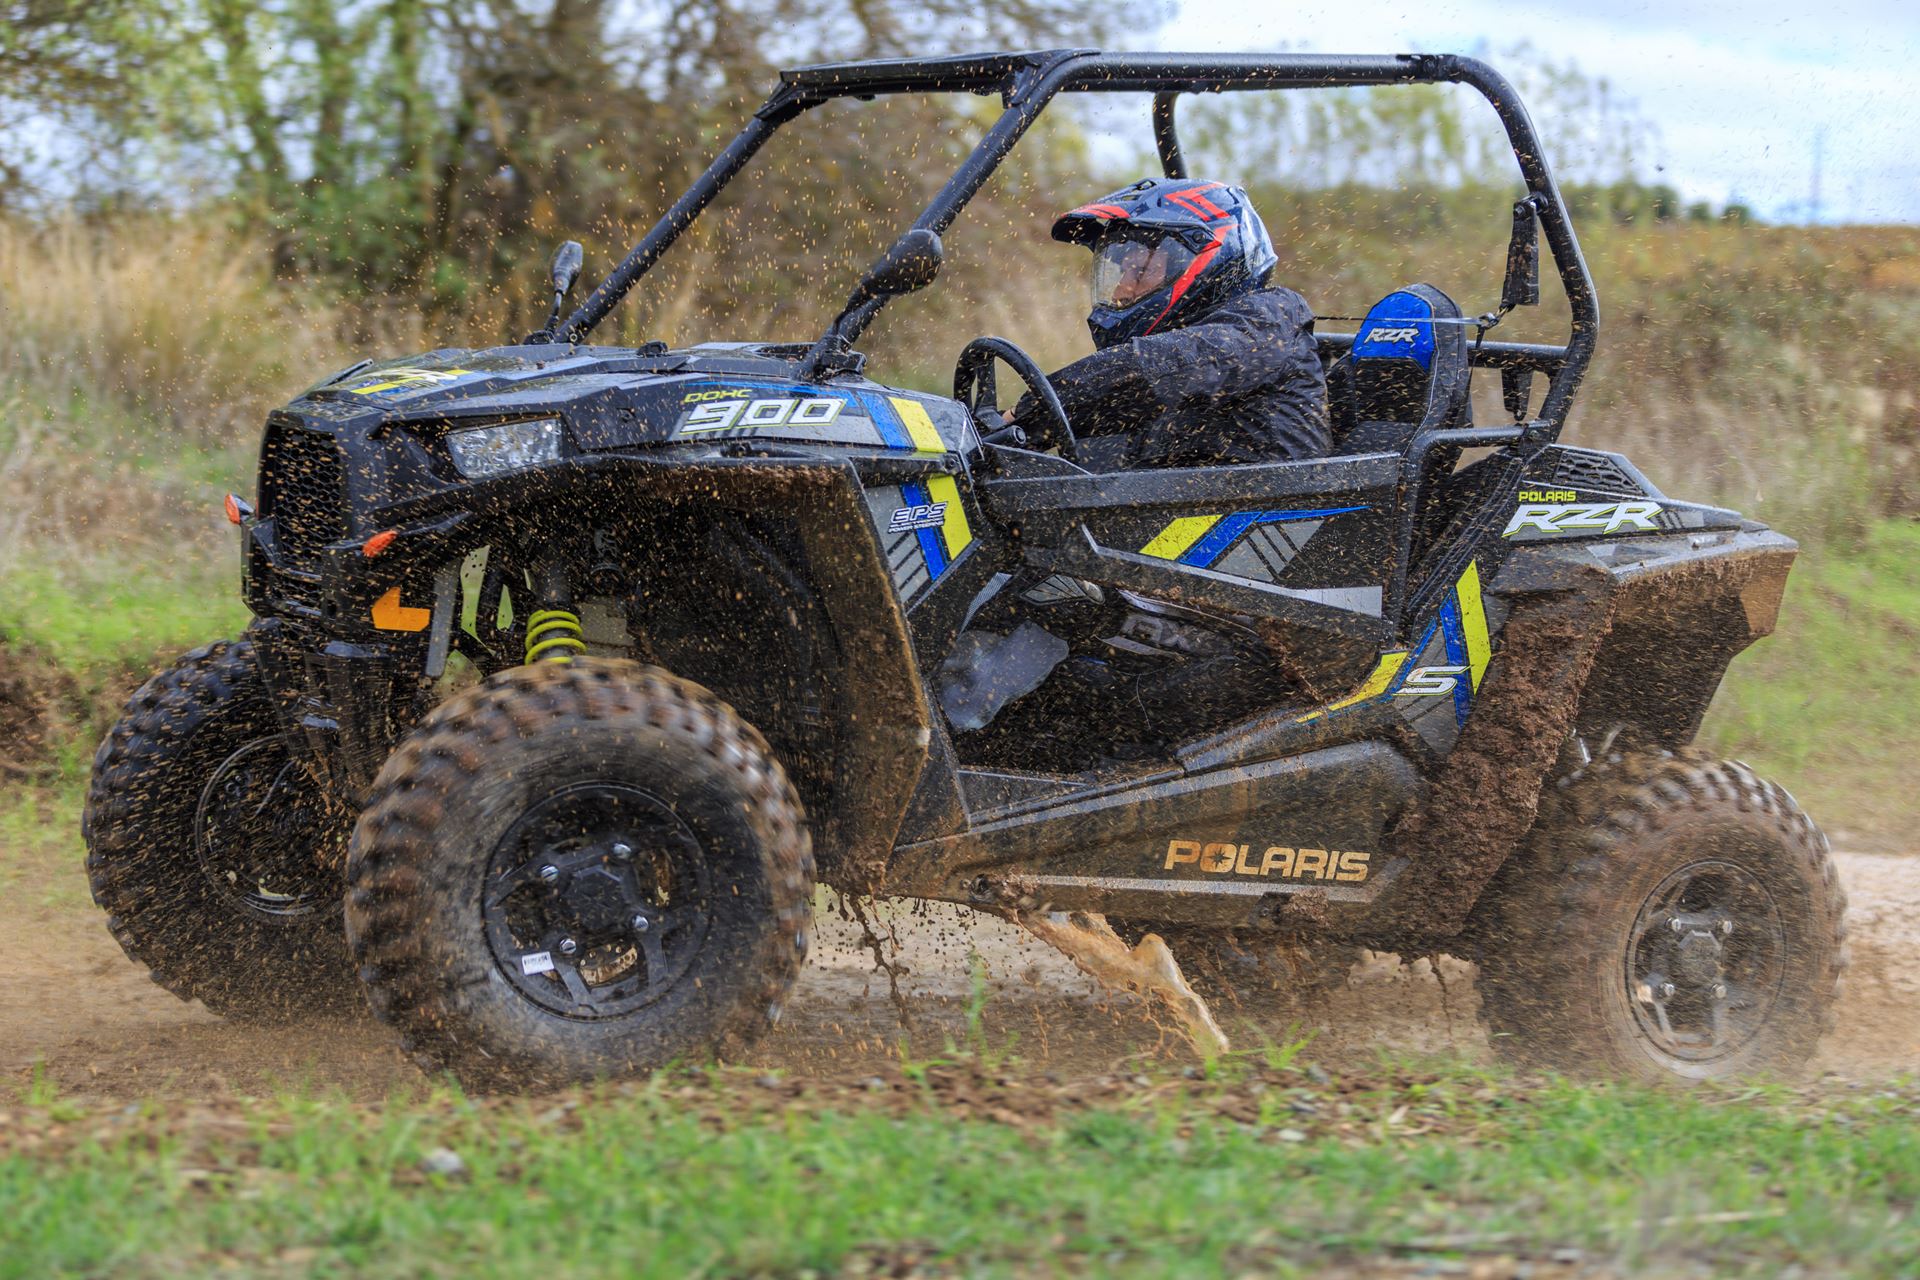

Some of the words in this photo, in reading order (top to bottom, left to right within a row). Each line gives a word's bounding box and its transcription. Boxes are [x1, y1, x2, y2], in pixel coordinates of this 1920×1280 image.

[1364, 328, 1419, 344] RZR
[684, 389, 753, 403] DOHC
[680, 399, 848, 435] 900
[1518, 491, 1576, 502] POLARIS
[890, 501, 948, 523] EPS
[1501, 502, 1664, 538] RZR
[1392, 666, 1471, 696] S
[1163, 839, 1371, 882] POLARIS
